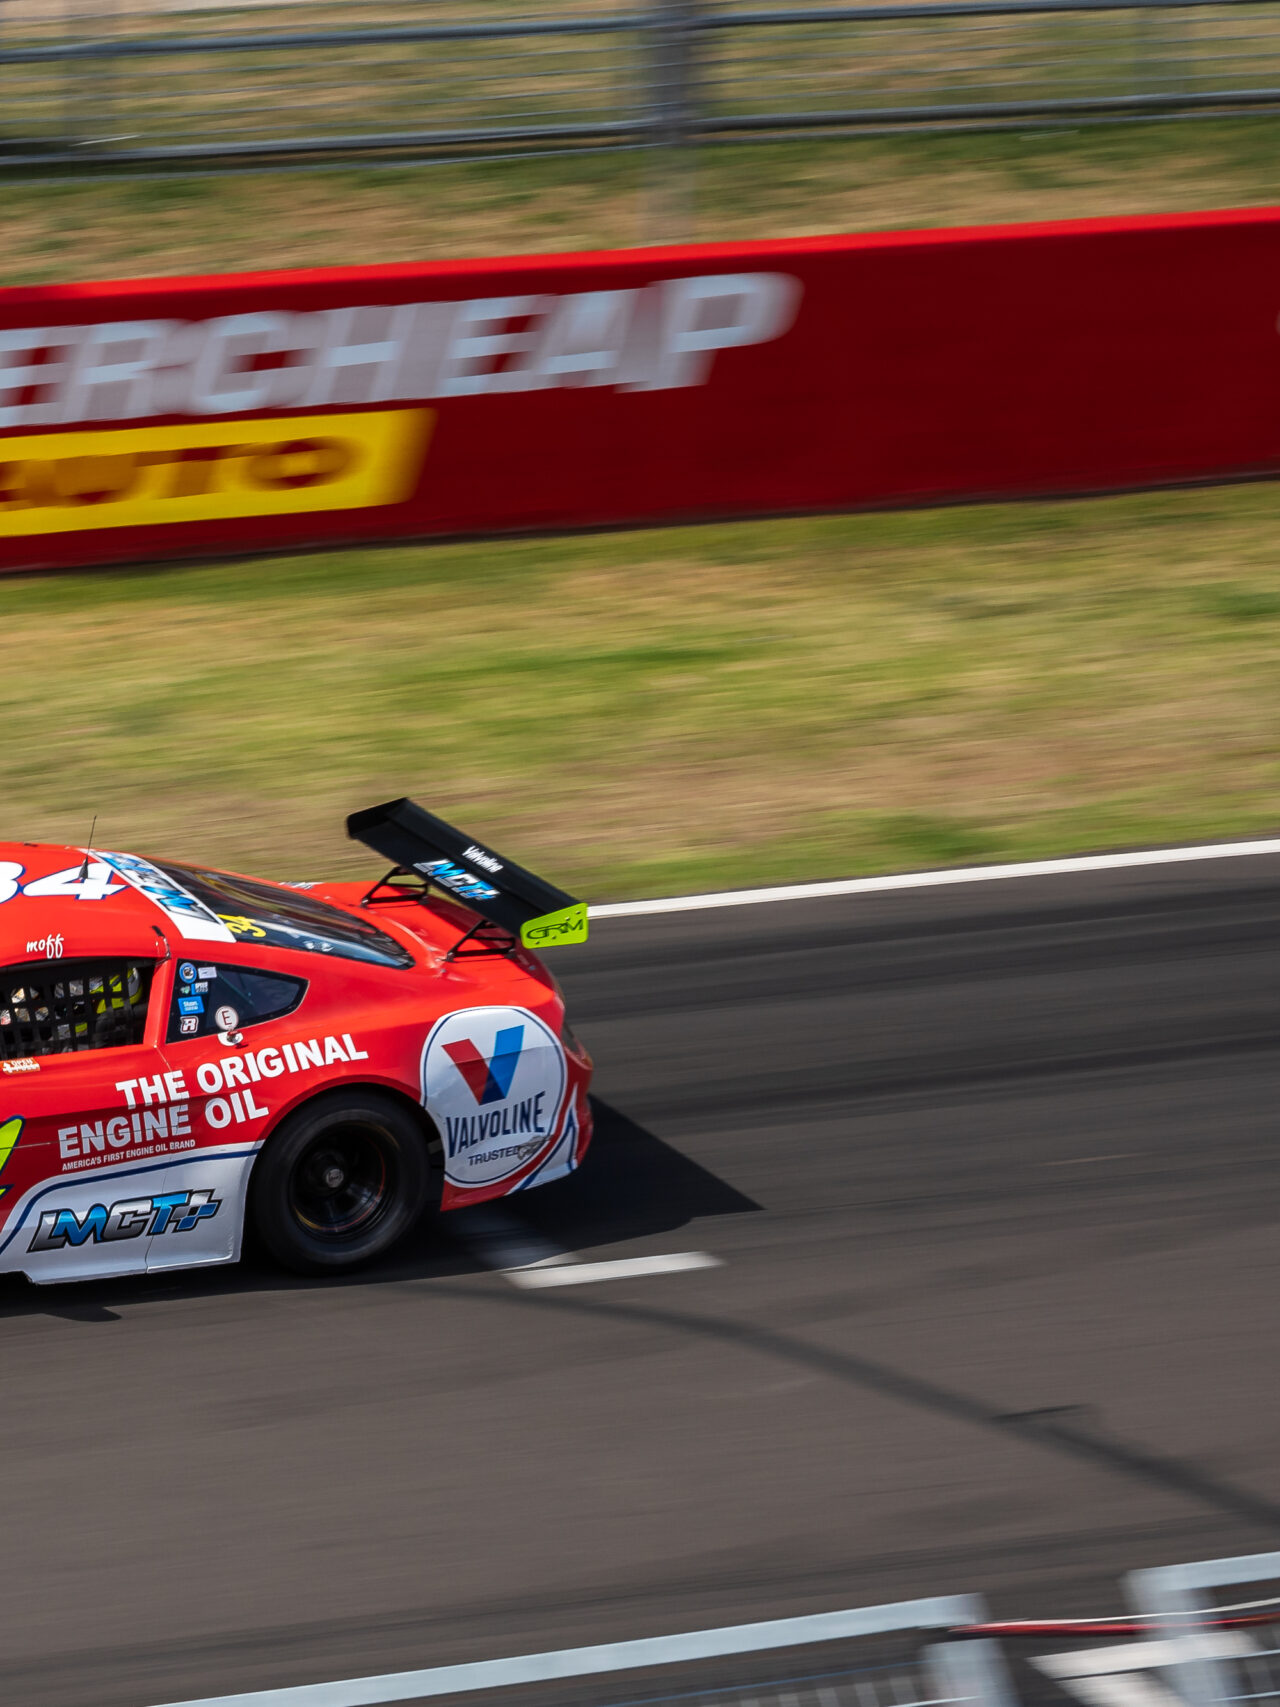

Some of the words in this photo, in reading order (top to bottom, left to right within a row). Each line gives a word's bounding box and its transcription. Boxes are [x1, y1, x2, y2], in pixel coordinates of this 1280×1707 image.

[526, 918, 584, 940] GRM
[26, 933, 64, 959] moff
[221, 1010, 233, 1026] E
[115, 1070, 190, 1109] THE
[196, 1033, 369, 1093] ORIGINAL
[57, 1104, 192, 1158] ENGINE
[204, 1088, 269, 1129] OIL
[446, 1090, 546, 1158] VALVOLINE
[103, 1151, 124, 1163] FIRST
[126, 1144, 155, 1158] ENGINE
[155, 1143, 168, 1152] OIL
[169, 1139, 196, 1150] BRAND
